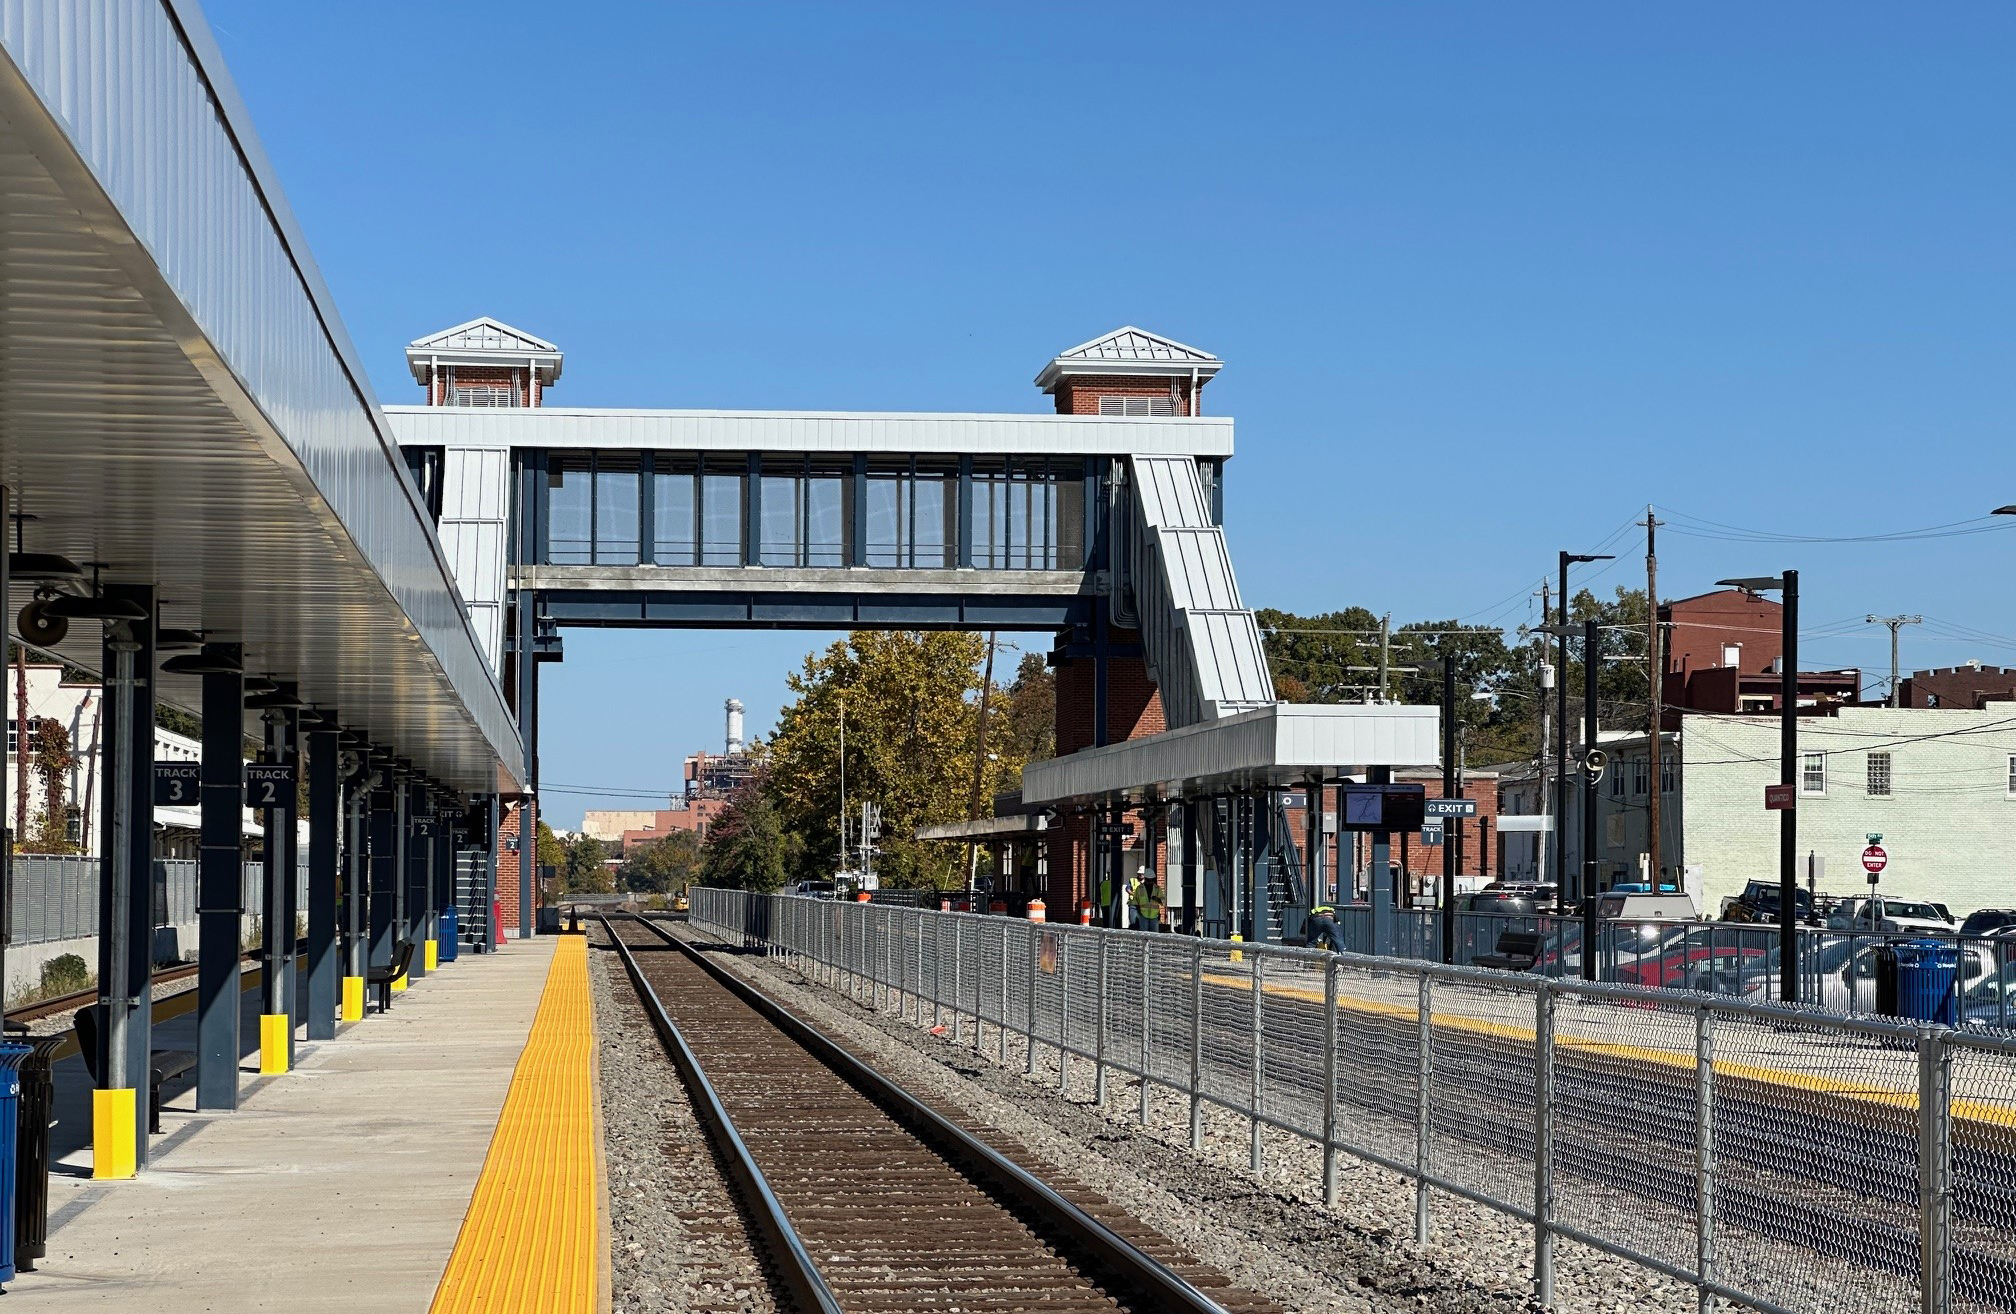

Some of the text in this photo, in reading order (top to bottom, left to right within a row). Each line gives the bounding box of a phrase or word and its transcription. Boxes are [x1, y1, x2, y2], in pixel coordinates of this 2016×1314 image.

[155, 768, 197, 778] TRACK
[248, 770, 289, 779] TRACK
[169, 780, 183, 800] 3
[261, 781, 276, 802] 2
[1769, 794, 1789, 803] QUANTICO
[1438, 804, 1463, 813] EXIT
[420, 824, 428, 835] 2
[457, 834, 463, 843] 2
[510, 841, 515, 849] 2
